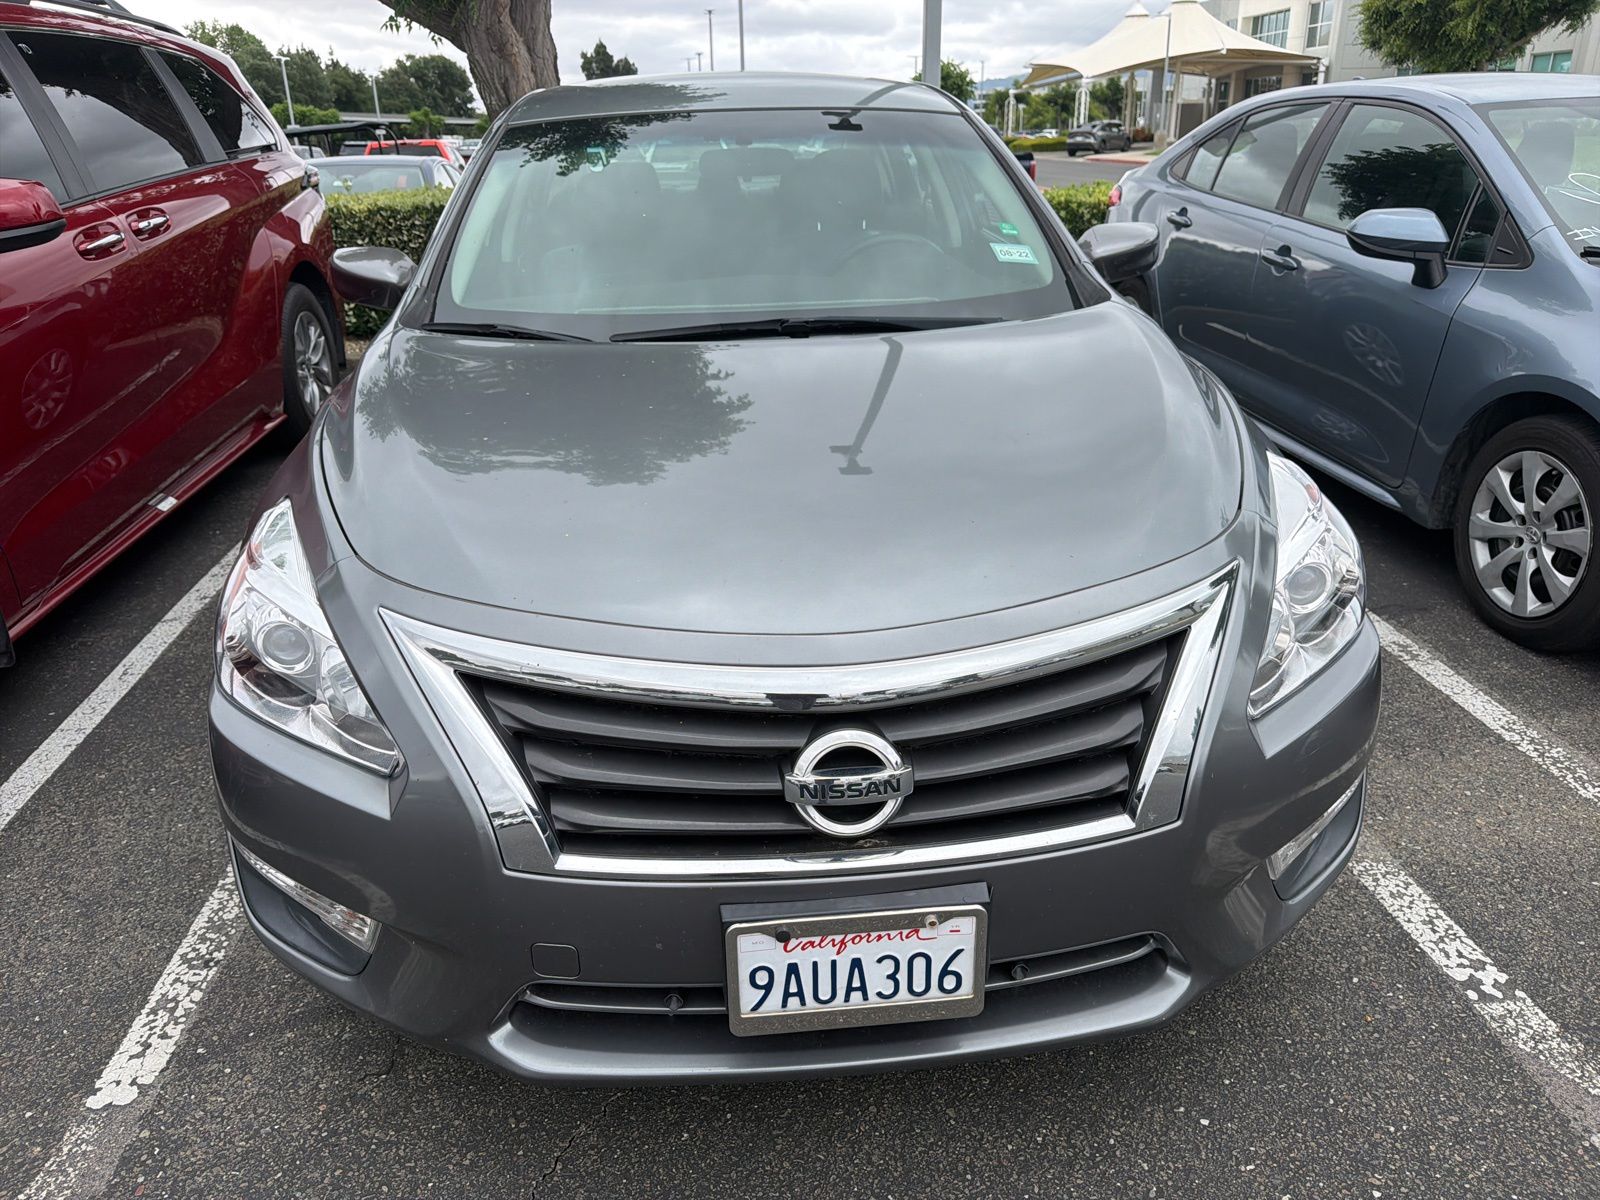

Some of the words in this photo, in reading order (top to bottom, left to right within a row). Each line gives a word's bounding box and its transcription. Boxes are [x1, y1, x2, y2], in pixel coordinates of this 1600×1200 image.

[799, 777, 901, 800] NISSAN
[782, 928, 938, 956] California
[749, 948, 966, 1012] 9AUA306
